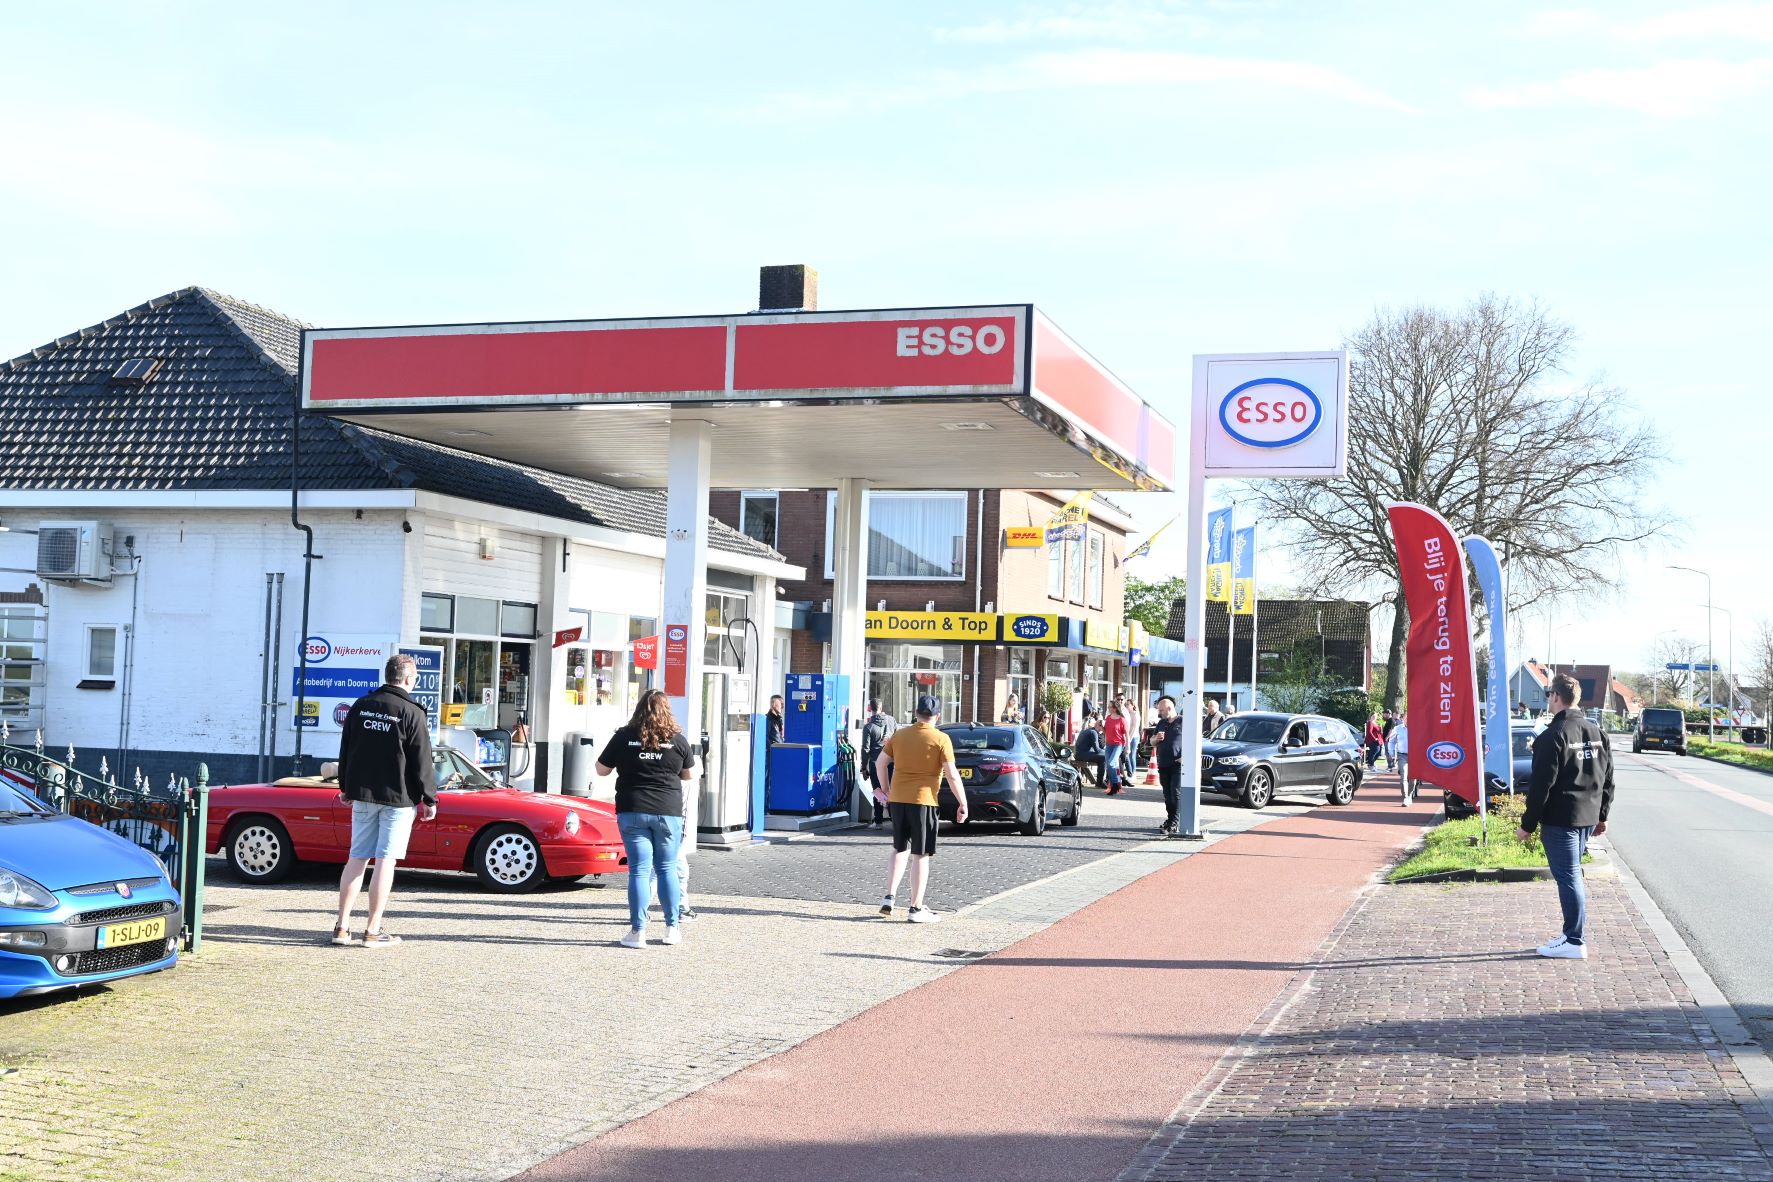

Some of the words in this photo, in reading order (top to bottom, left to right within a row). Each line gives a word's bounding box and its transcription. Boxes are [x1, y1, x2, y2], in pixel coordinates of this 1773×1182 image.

[896, 325, 1005, 356] ESSO
[1236, 396, 1307, 423] Esso
[1424, 537, 1446, 570] Blij
[1427, 572, 1448, 592] je
[865, 617, 883, 629] an
[888, 617, 936, 631] Doorn
[942, 617, 953, 631] &
[959, 617, 988, 633] Top
[1019, 620, 1042, 629] SINDS
[1020, 627, 1041, 636] 1920
[1434, 596, 1450, 650] terug
[1439, 655, 1454, 676] te
[1488, 649, 1496, 680] een
[347, 678, 368, 688] Doorn
[415, 673, 435, 690] 210
[1439, 682, 1455, 724] zien
[1489, 684, 1497, 720] Win
[337, 709, 350, 722] FIA
[363, 719, 391, 732] CREW
[638, 752, 663, 760] CREW
[1433, 748, 1459, 760] Esso
[111, 922, 160, 943] 1-SLJ-09
